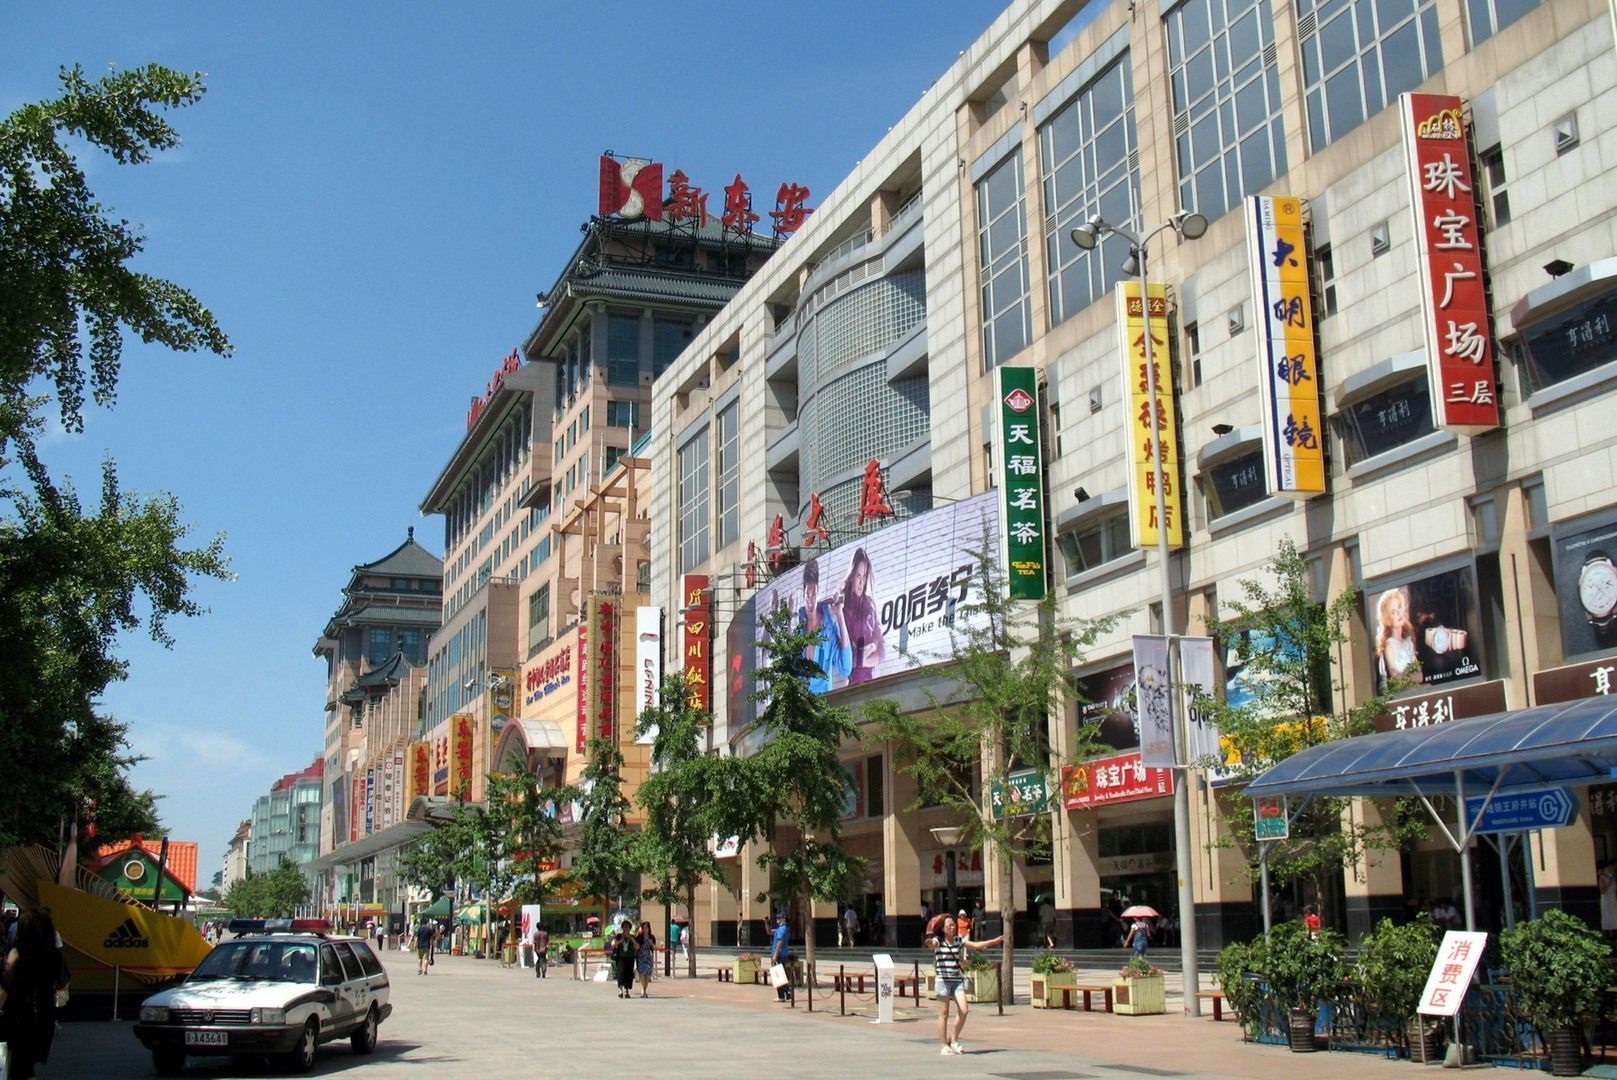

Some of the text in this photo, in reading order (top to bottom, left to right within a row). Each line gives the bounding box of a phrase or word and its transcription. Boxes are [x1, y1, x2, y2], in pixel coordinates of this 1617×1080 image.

[1424, 153, 1486, 364] 珠宝广场
[1447, 380, 1494, 405] 三层
[1008, 424, 1041, 545] 天福茗茶
[908, 621, 935, 638] Make
[937, 611, 955, 627] the
[1455, 663, 1480, 676] OMEGA
[1096, 760, 1147, 789] 珠宝广场
[104, 937, 149, 949] adidas
[1428, 940, 1472, 1008] 消费区
